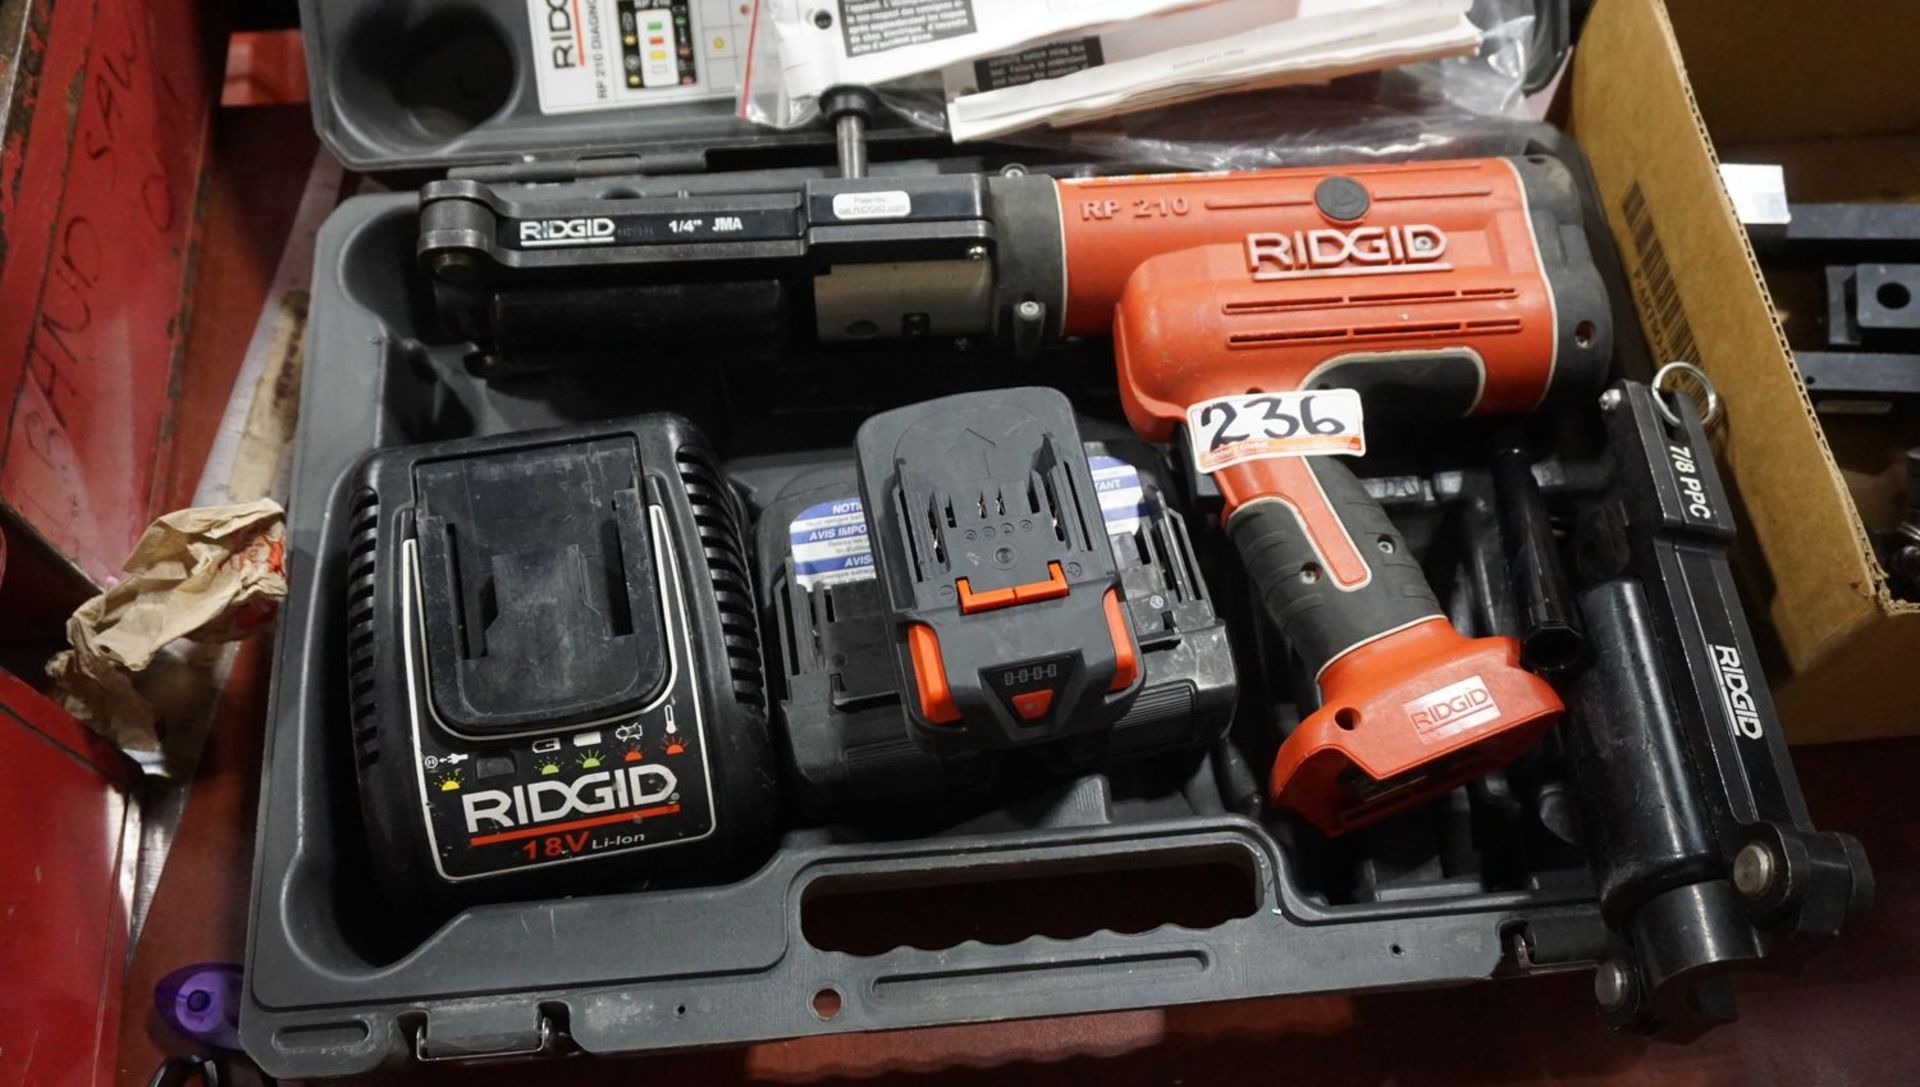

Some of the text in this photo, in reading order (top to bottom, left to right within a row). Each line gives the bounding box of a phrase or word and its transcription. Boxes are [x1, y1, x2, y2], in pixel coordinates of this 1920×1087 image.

[593, 54, 605, 81] 210
[597, 85, 607, 99] RP
[519, 216, 616, 241] RIDGID
[668, 218, 703, 235] 1/4"
[711, 217, 743, 232] JMA
[1081, 197, 1190, 222] RP 210
[24, 45, 136, 471] BAND SAW
[1244, 223, 1450, 273] RIDGID
[1200, 395, 1346, 452] 236
[1668, 445, 1712, 520] 7/8 PPC
[808, 527, 836, 542] AVIS
[1409, 687, 1491, 731] RIDGID
[1714, 644, 1764, 741] RIDGID
[461, 763, 679, 834] RIDGID
[522, 831, 645, 861] 18V Li-Ion
